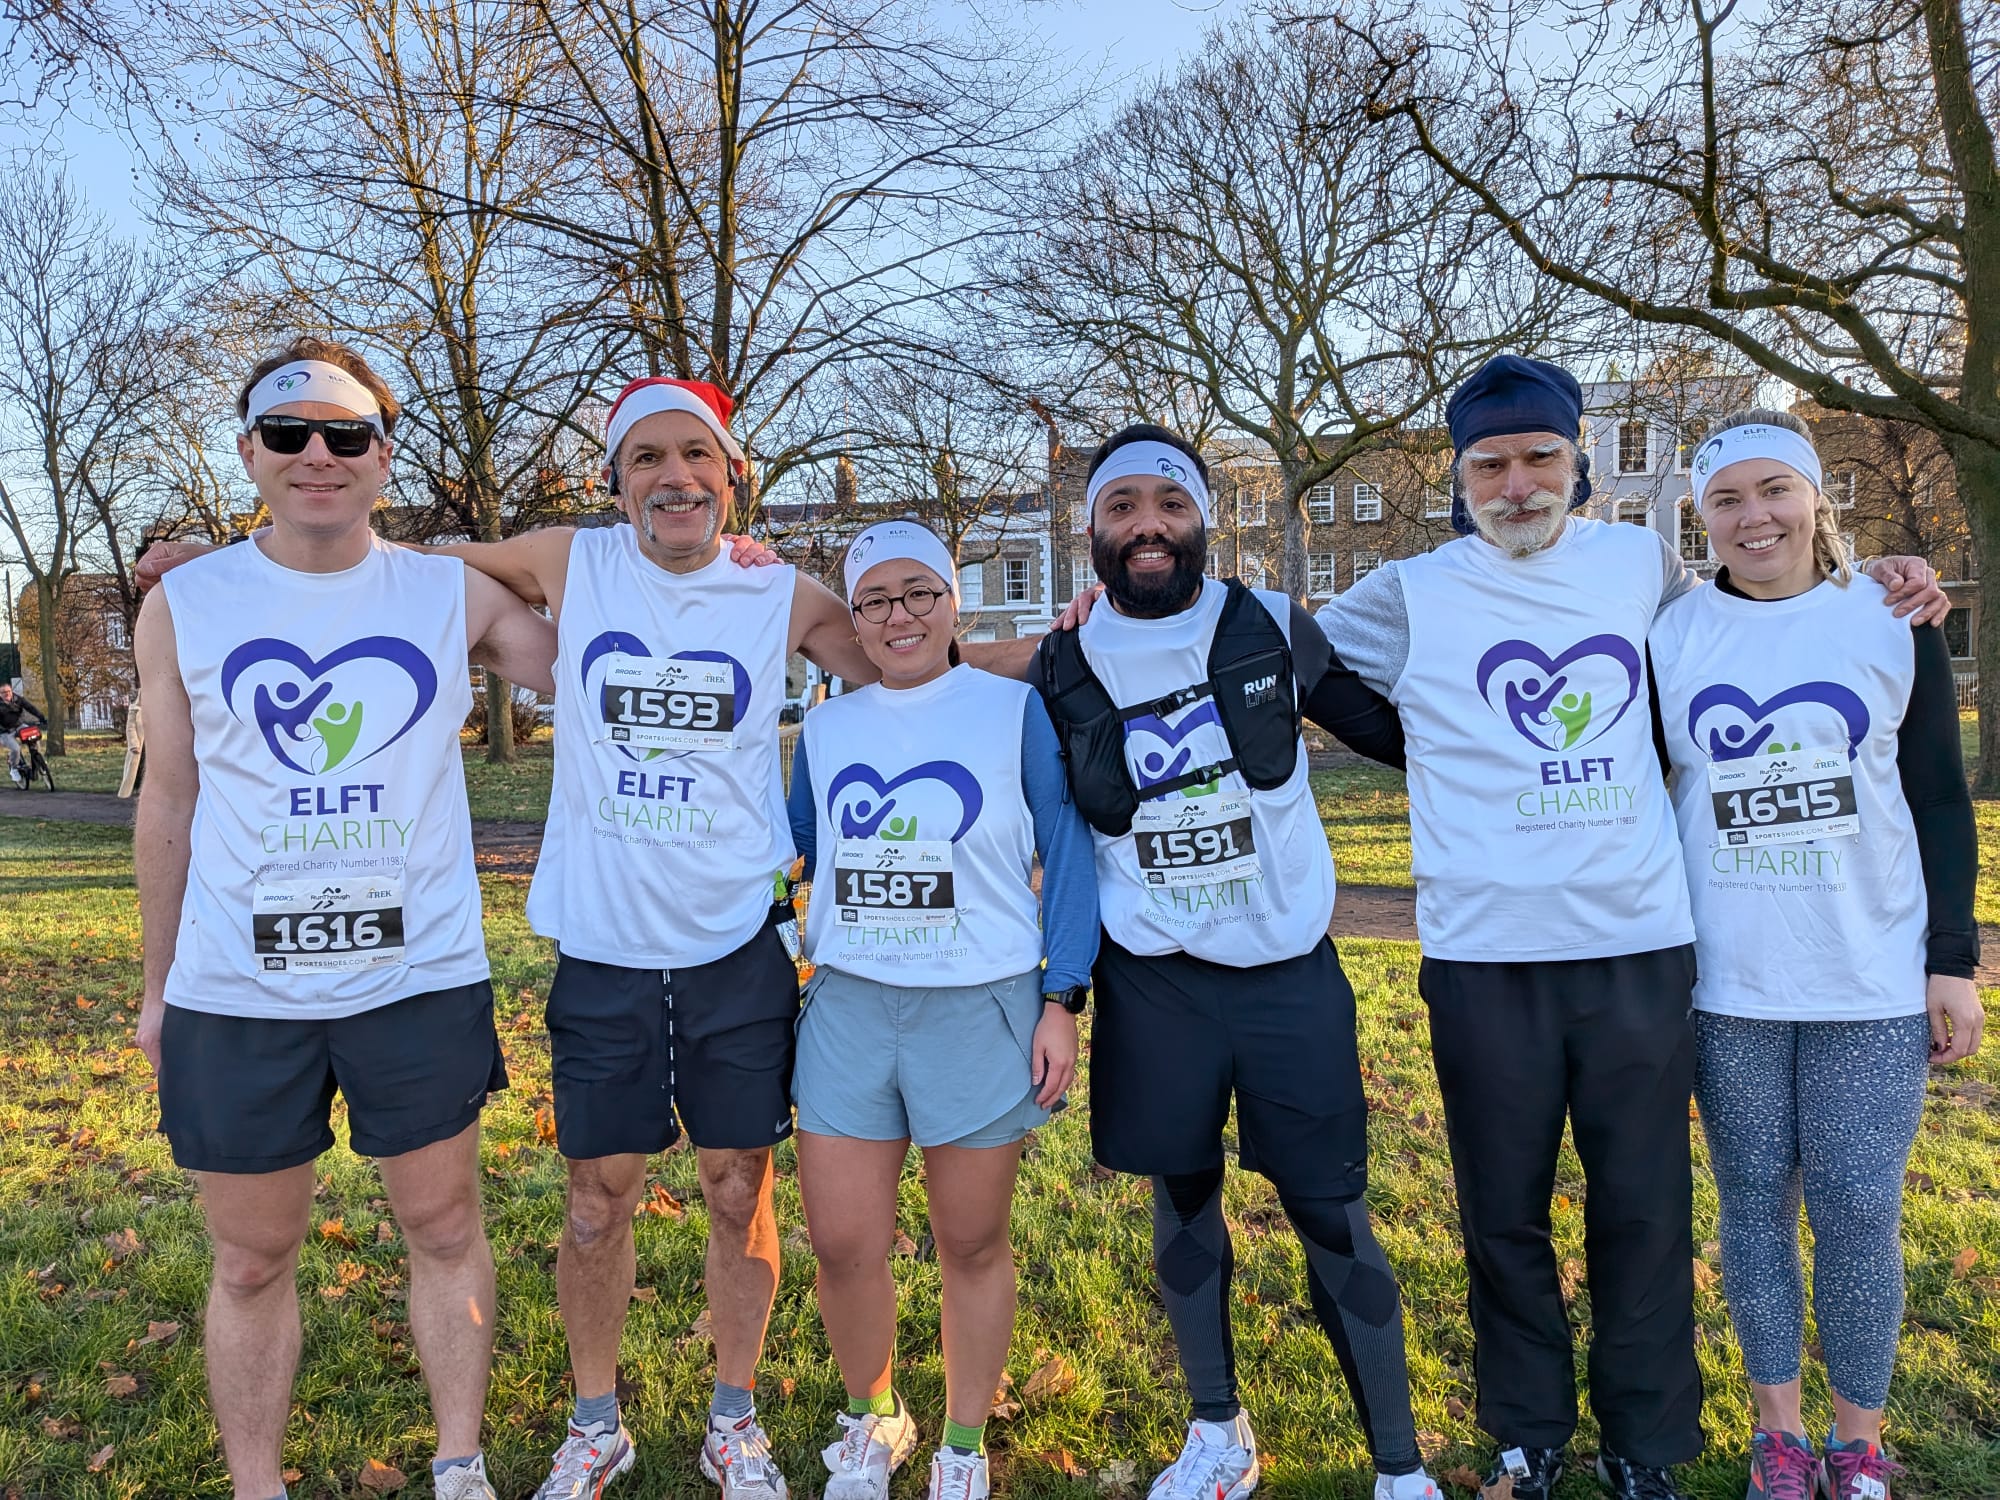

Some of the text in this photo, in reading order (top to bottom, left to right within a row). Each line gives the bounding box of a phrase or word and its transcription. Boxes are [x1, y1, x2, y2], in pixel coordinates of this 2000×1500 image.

[705, 675, 726, 684] TREK
[1244, 674, 1277, 696] RUN
[617, 689, 720, 729] 1593
[1245, 688, 1276, 709] LITE
[1540, 757, 1614, 786] ELFT
[1759, 766, 1798, 775] RunThrough
[1815, 760, 1840, 769] TREK
[617, 770, 696, 802] ELFT
[289, 784, 385, 816] ELFT
[1221, 803, 1240, 813] TREK
[1517, 785, 1636, 816] CHARITY
[1727, 781, 1841, 826] 1645
[598, 796, 717, 834] CHARITY
[1515, 821, 1556, 834] Registered
[1558, 820, 1586, 830] Charity
[1587, 818, 1614, 828] Number
[261, 819, 414, 853] CHARITY
[652, 838, 684, 848] Number
[1150, 825, 1240, 866] 1591
[259, 861, 300, 874] egistered
[303, 859, 338, 872] Charity
[340, 857, 378, 869] Number
[1712, 848, 1842, 876] CHARITY
[369, 890, 392, 899] TREK
[847, 872, 938, 906] 1587
[1151, 874, 1265, 913] CHARITY
[1708, 879, 1748, 890] Registered
[1750, 881, 1777, 893] Charity
[1779, 882, 1813, 892] Number
[847, 917, 960, 945] CHARITY
[1144, 908, 1185, 928] Registered
[1186, 919, 1212, 930] Charity
[1214, 914, 1243, 927] Number
[273, 913, 383, 951] 1616
[295, 959, 367, 967] SPORTSSHOES.COM
[838, 948, 968, 962] Registered Charity Number 1198337
